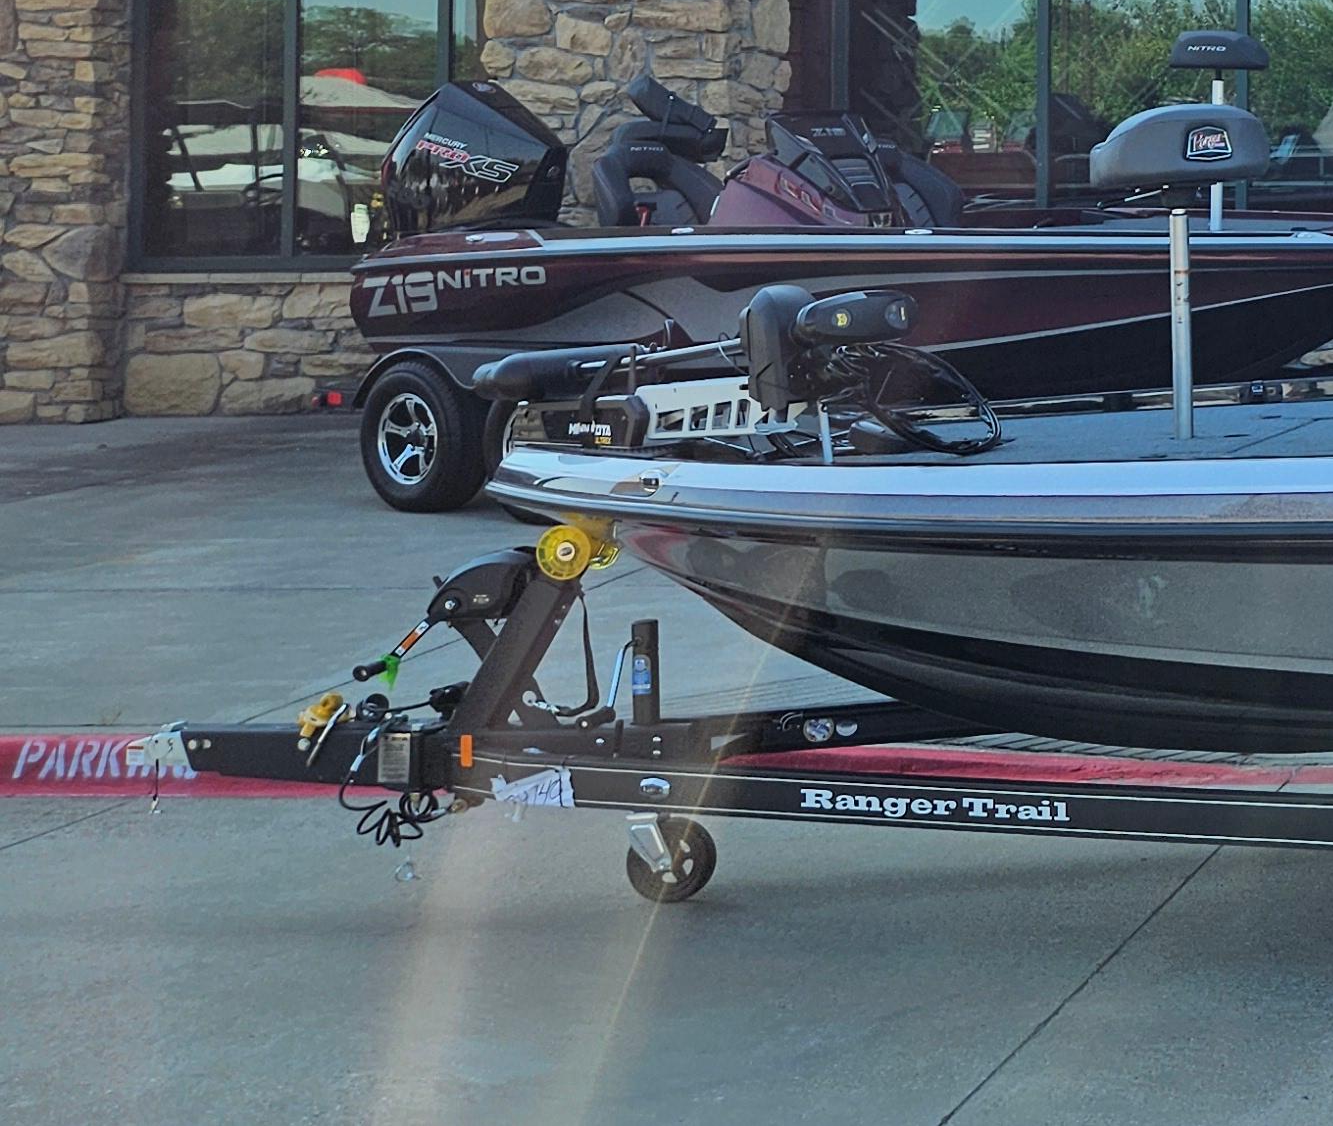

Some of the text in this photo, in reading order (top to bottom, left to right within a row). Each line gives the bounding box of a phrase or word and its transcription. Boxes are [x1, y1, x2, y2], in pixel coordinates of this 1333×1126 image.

[416, 139, 519, 183] PRO XS
[424, 132, 468, 150] MERCURY
[362, 271, 439, 318] Z19
[12, 737, 198, 780] PARK
[800, 788, 1071, 822] Ranger Trail
